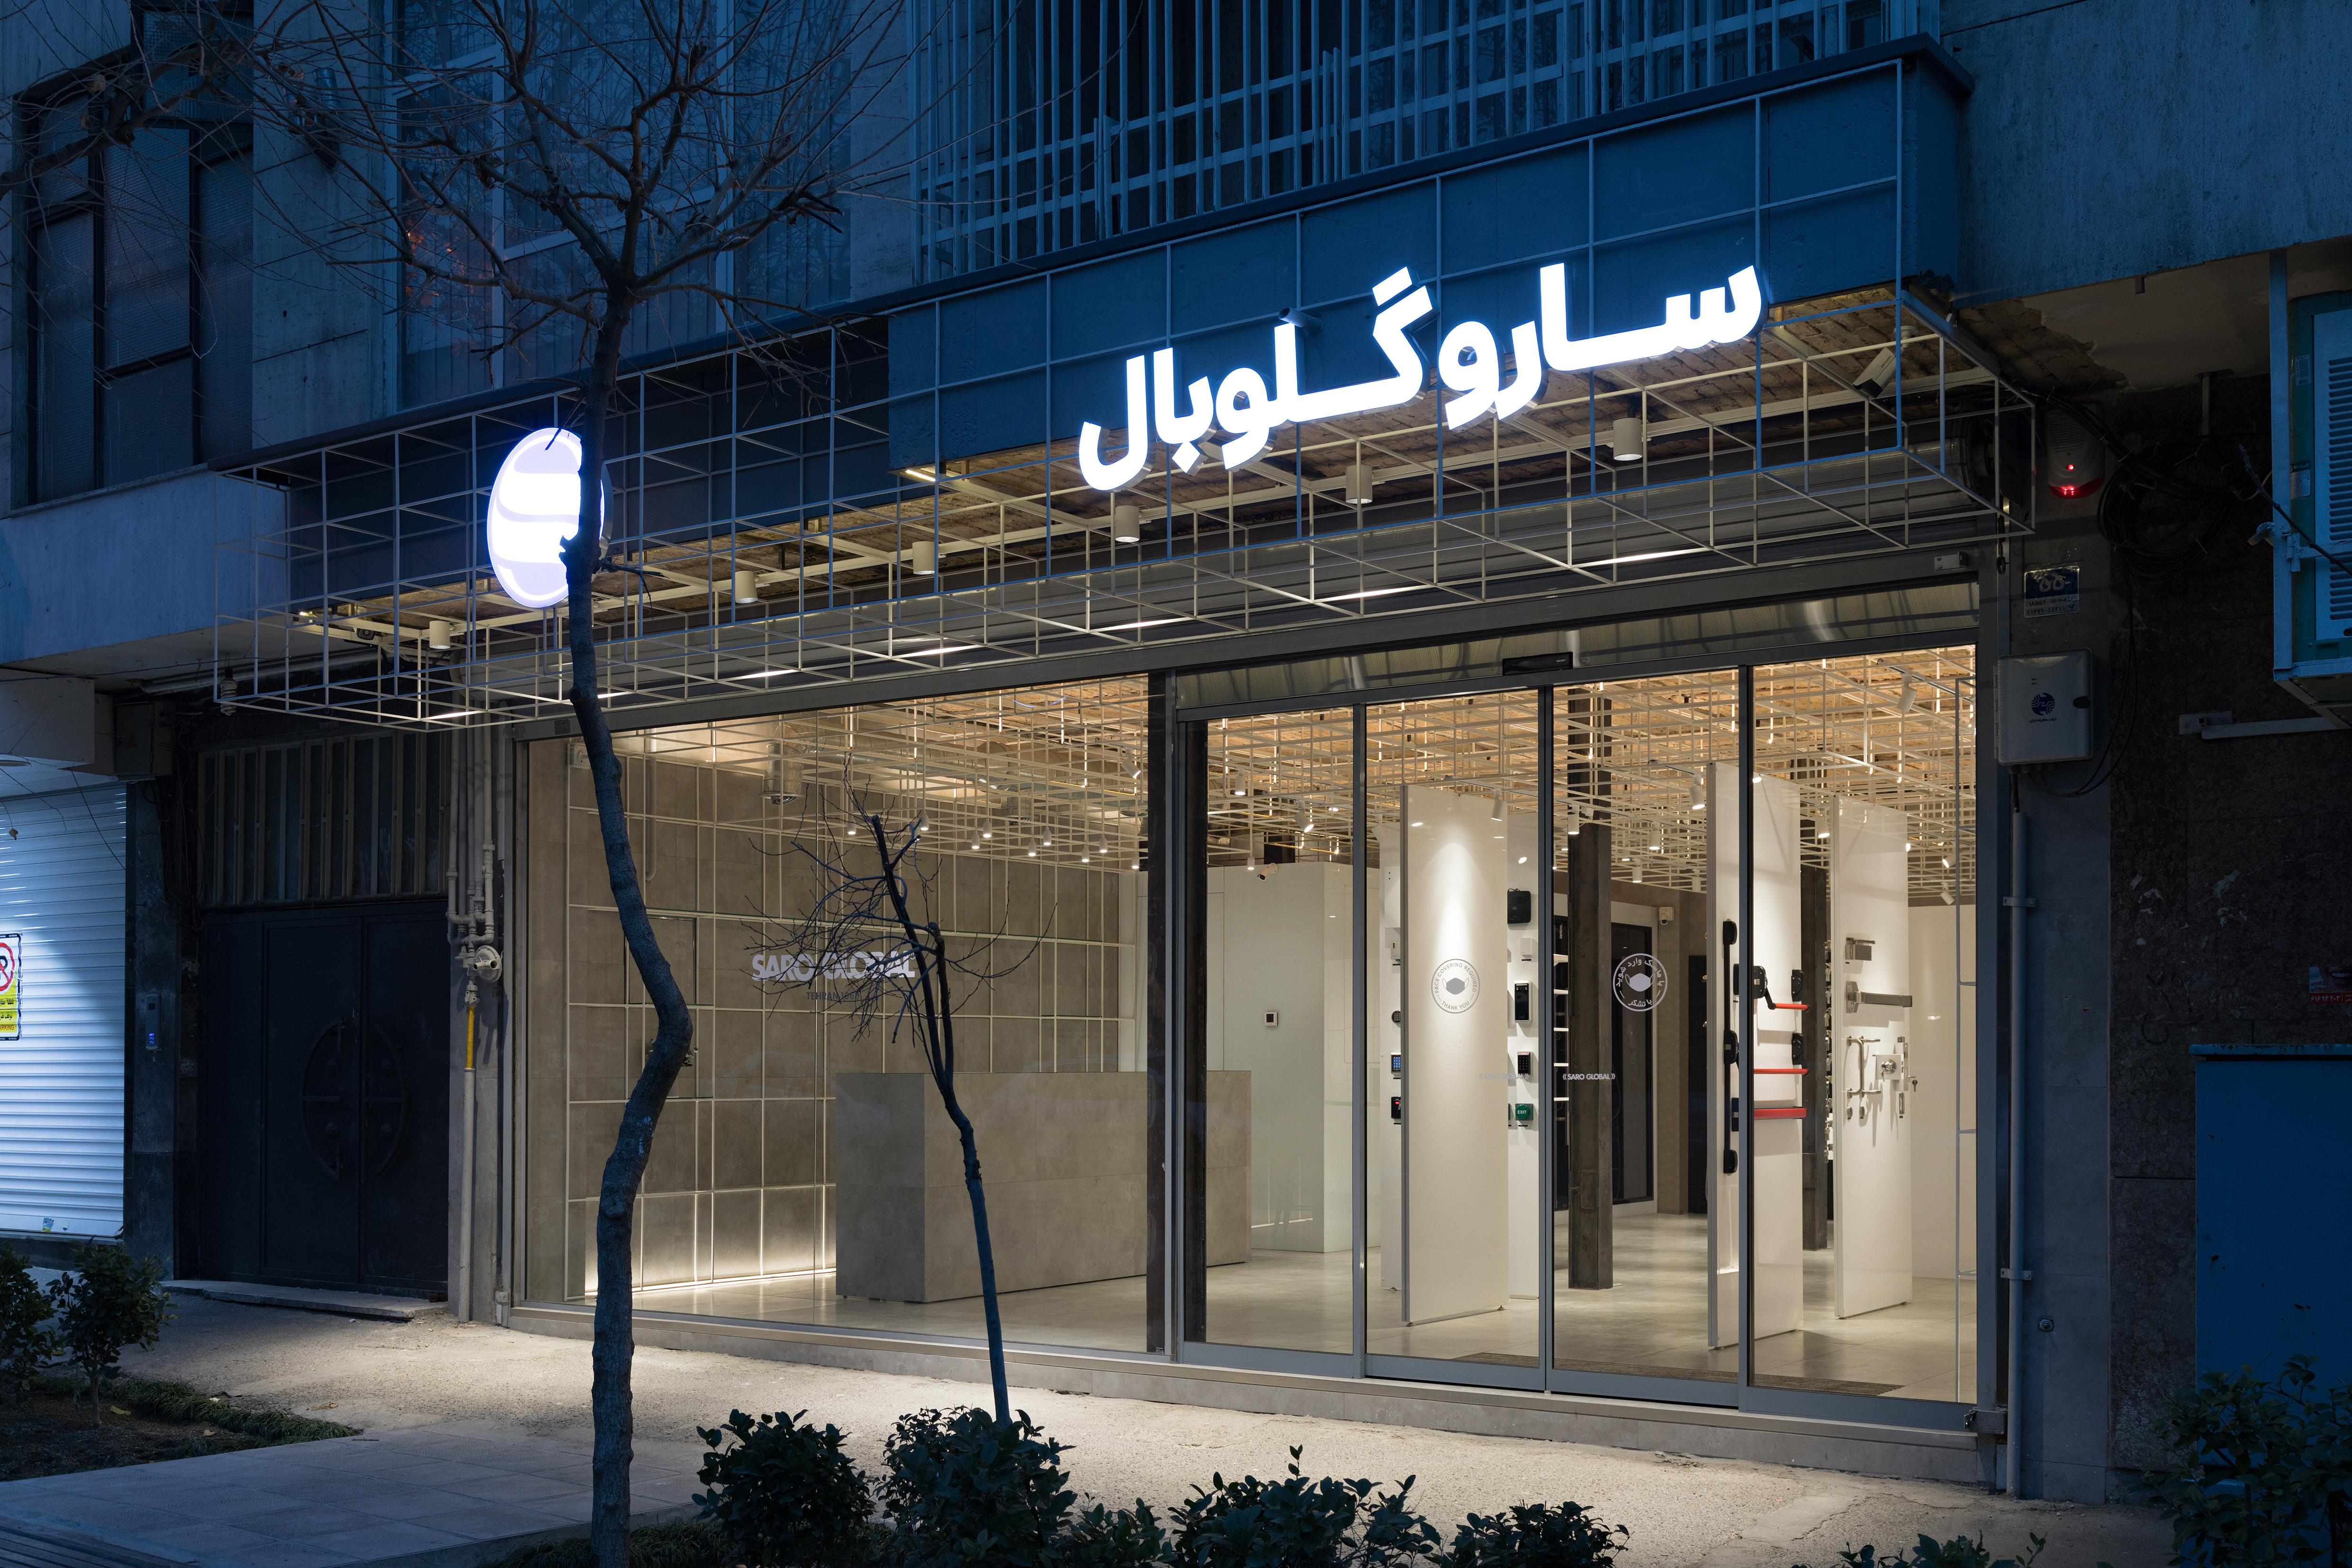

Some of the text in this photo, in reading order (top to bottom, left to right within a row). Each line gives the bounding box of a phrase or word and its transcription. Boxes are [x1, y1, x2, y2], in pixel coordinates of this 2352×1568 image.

[752, 954, 815, 981] SARO
[1628, 957, 1642, 967] وارد
[1644, 960, 1662, 978] ماسک
[1437, 963, 1463, 977] COVERING
[1464, 965, 1477, 992] REQUIRED
[1616, 967, 1626, 987] شوید
[806, 992, 839, 1000] TEHRAN
[1628, 999, 1646, 1007] تشکر
[1442, 1000, 1470, 1010] THANK YOU
